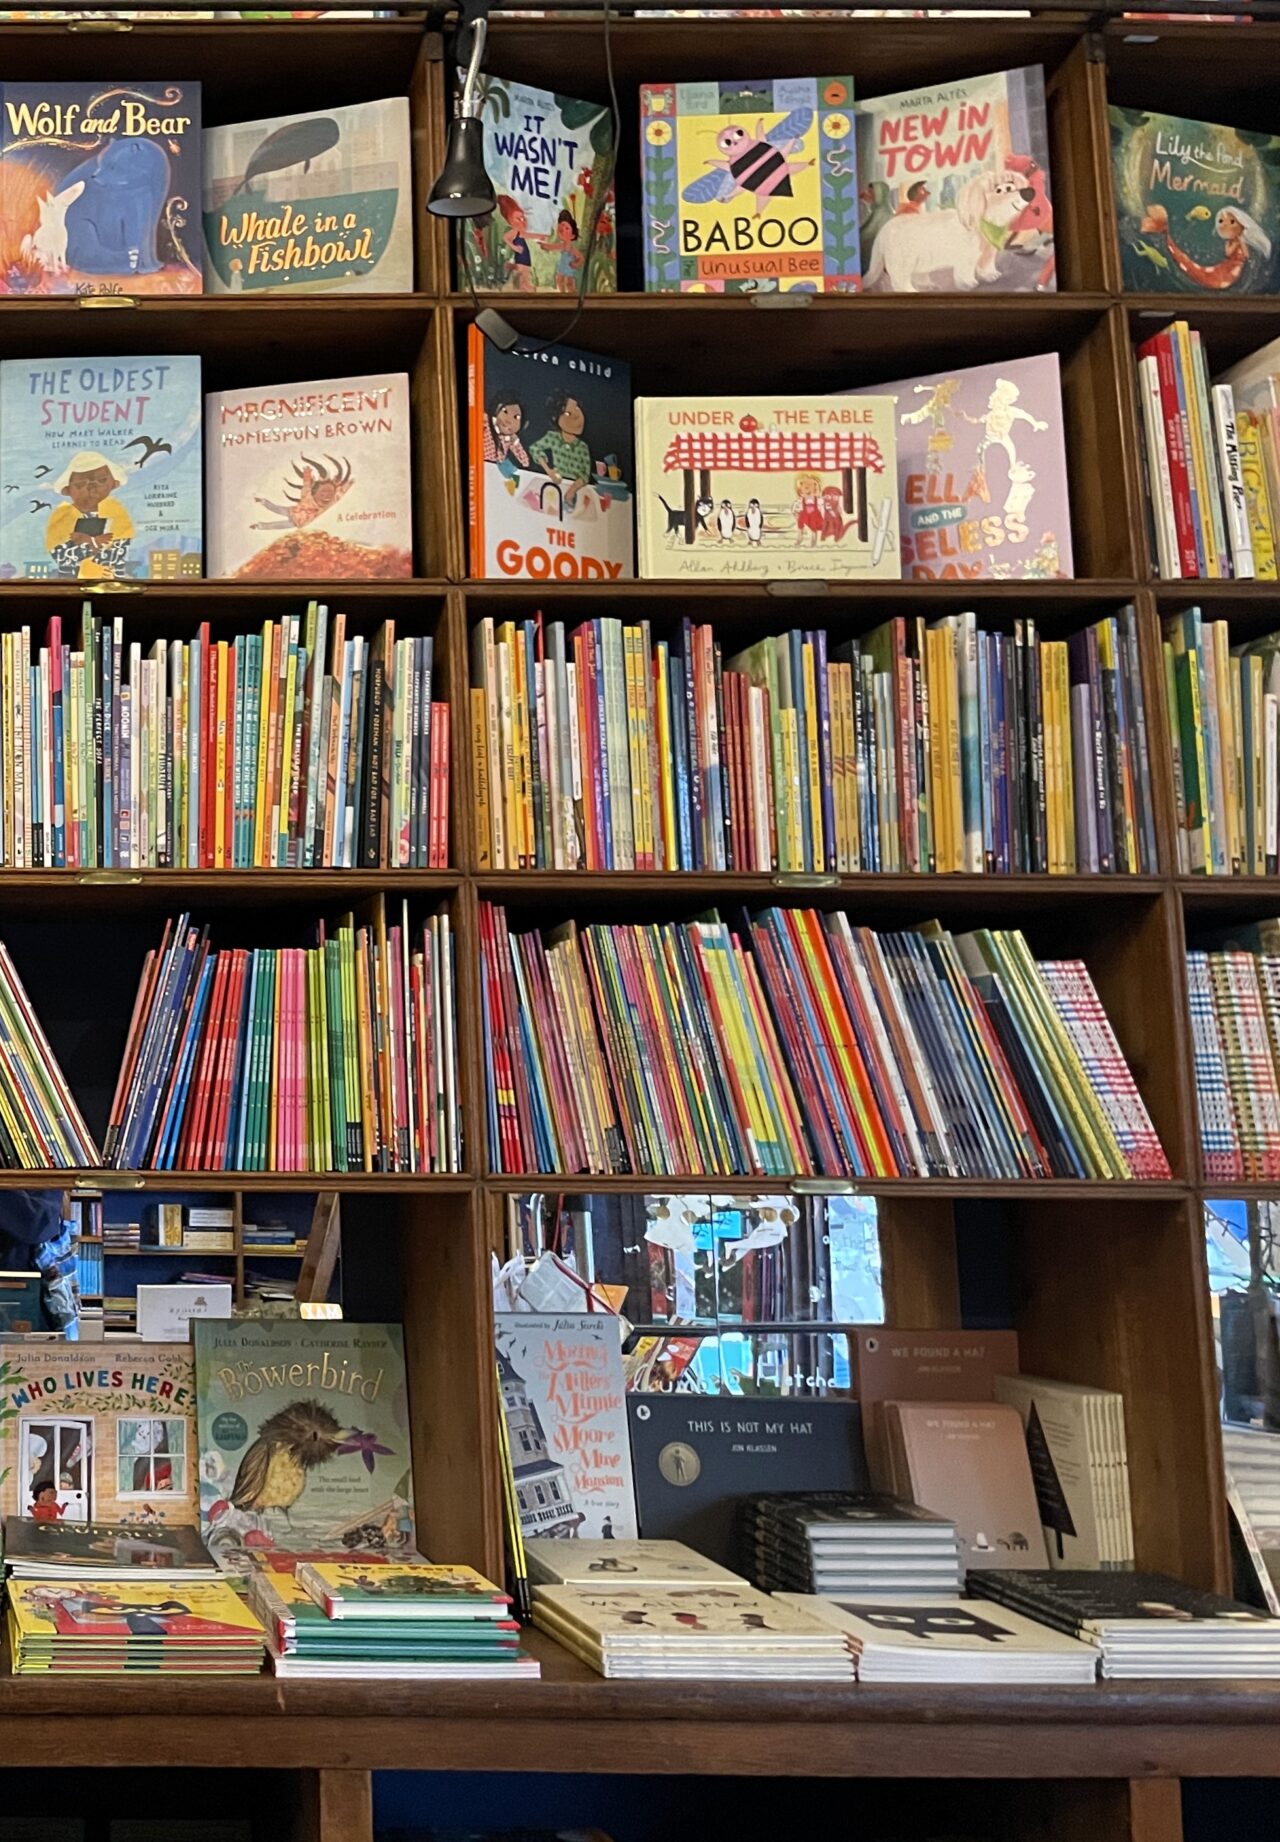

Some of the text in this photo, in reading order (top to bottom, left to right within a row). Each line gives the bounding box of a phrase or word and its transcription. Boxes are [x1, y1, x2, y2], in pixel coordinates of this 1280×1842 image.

[5, 99, 192, 137] Wolf and Bear
[898, 98, 934, 111] MARTA
[523, 114, 546, 133] IT
[879, 106, 950, 147] NEW
[493, 131, 579, 171] WASN'T
[878, 128, 994, 178] TOWN
[1156, 131, 1245, 169] Lily the Pond
[510, 164, 562, 206] ME!
[1149, 158, 1246, 206] Mermaid
[220, 204, 357, 248] Whale in a
[682, 216, 820, 253] BABOO
[247, 228, 374, 275] Fishbowl
[787, 258, 821, 273] Bee
[29, 366, 170, 395] THE OLDEST
[568, 359, 613, 378] child
[41, 396, 151, 426] STUDENT
[669, 409, 874, 426] UNDER THE TABLE
[45, 428, 135, 439] HOW MARY WALKER
[103, 438, 126, 447] READ
[325, 418, 393, 439] BROWN
[1225, 422, 1235, 440] The
[1226, 444, 1241, 482] Missing
[904, 465, 991, 505] ELLA
[345, 510, 396, 522] Celebration
[916, 507, 962, 526] AND THE
[546, 527, 576, 549] THE
[900, 513, 1030, 566] SELESS
[495, 538, 624, 580] GOODY
[678, 561, 714, 572] Allan
[911, 559, 983, 580] DAY
[374, 668, 382, 706] MORPURGO
[120, 705, 129, 738] MOOMIN
[293, 739, 302, 775] BRILLIANT
[16, 1353, 184, 1363] Julia Donaldson Rebecca Cobb
[913, 1347, 951, 1358] FOUND
[11, 1376, 58, 1409] WHO
[64, 1370, 124, 1390] LIVES
[219, 1351, 385, 1404] Bowerbird
[687, 1420, 813, 1435] THIS IS NOT MY HAT
[747, 1444, 778, 1453] KLASSEN
